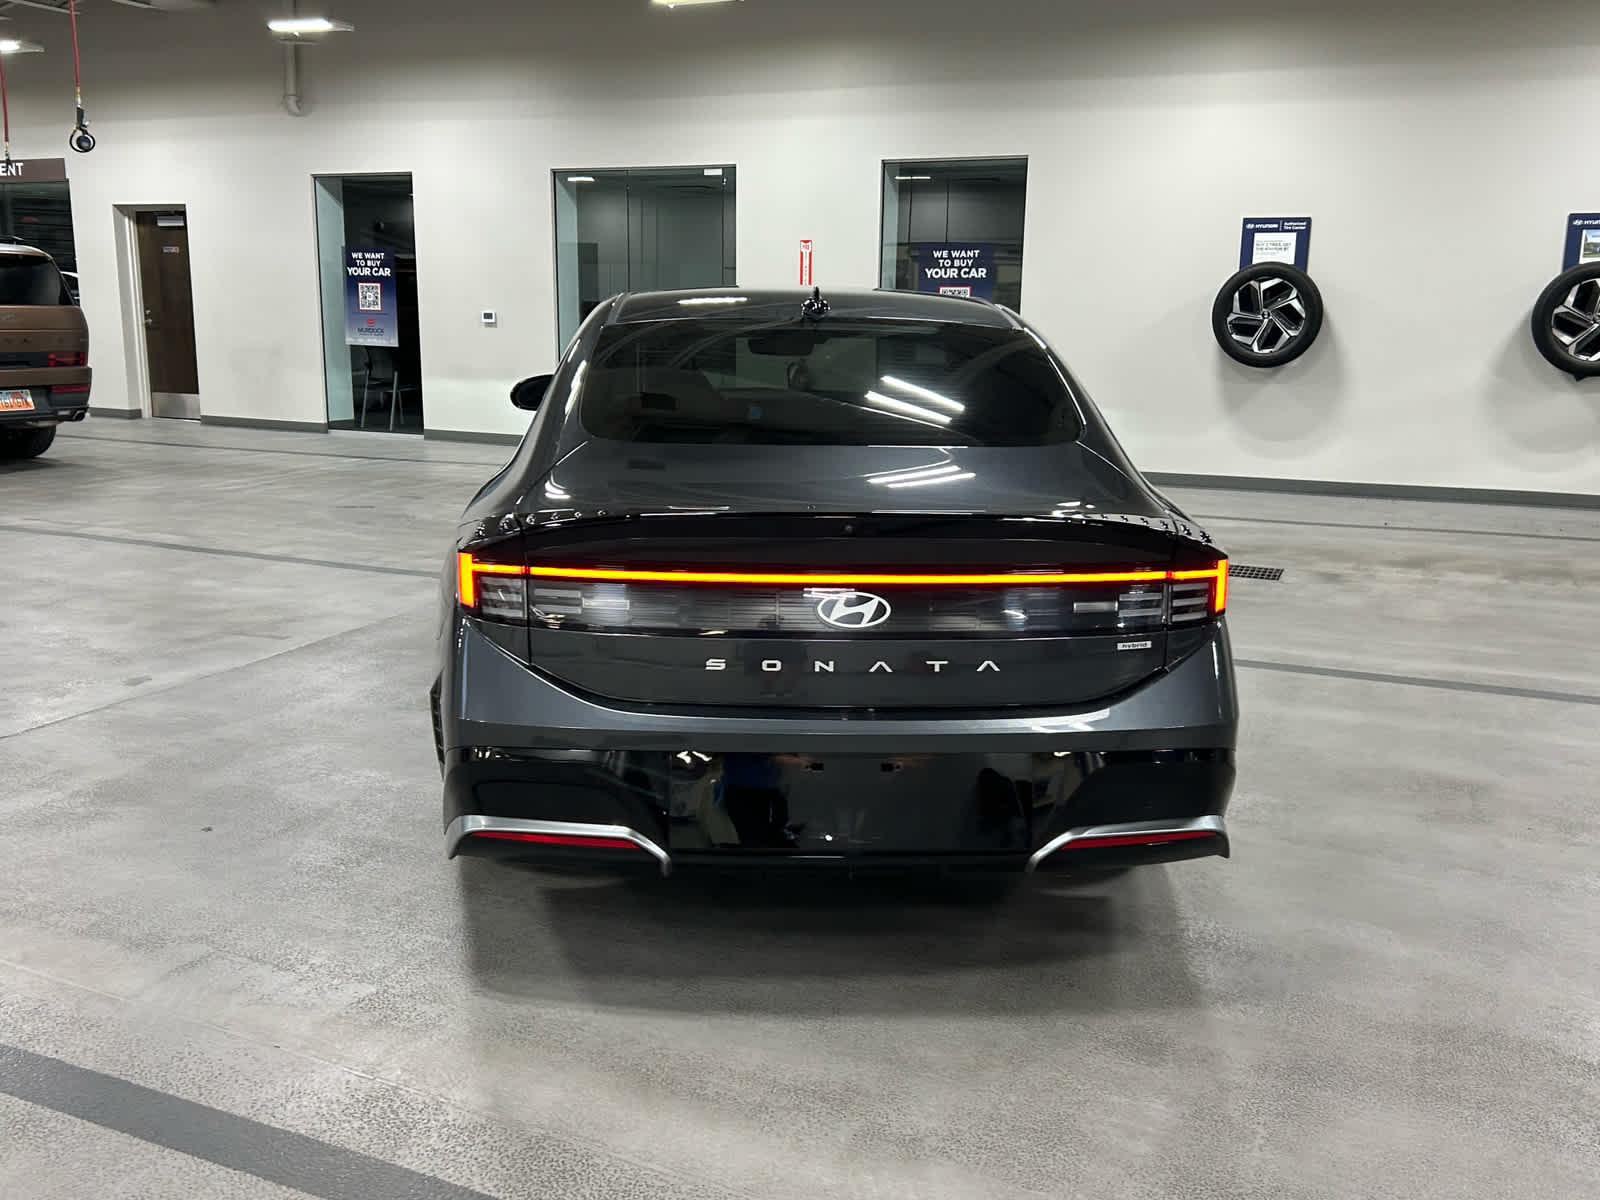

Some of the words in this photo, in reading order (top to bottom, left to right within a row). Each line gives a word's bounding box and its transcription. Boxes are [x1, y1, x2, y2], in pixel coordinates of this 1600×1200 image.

[0, 162, 24, 176] ENT
[364, 252, 385, 260] WANT
[933, 250, 949, 258] WE
[951, 250, 980, 258] WANT
[939, 259, 952, 267] TO
[954, 259, 973, 267] BUY
[346, 267, 371, 276] YOUR
[372, 267, 391, 277] CAR
[925, 268, 958, 278] YOUR
[960, 268, 987, 278] CAR
[705, 658, 1001, 672] SONATA
